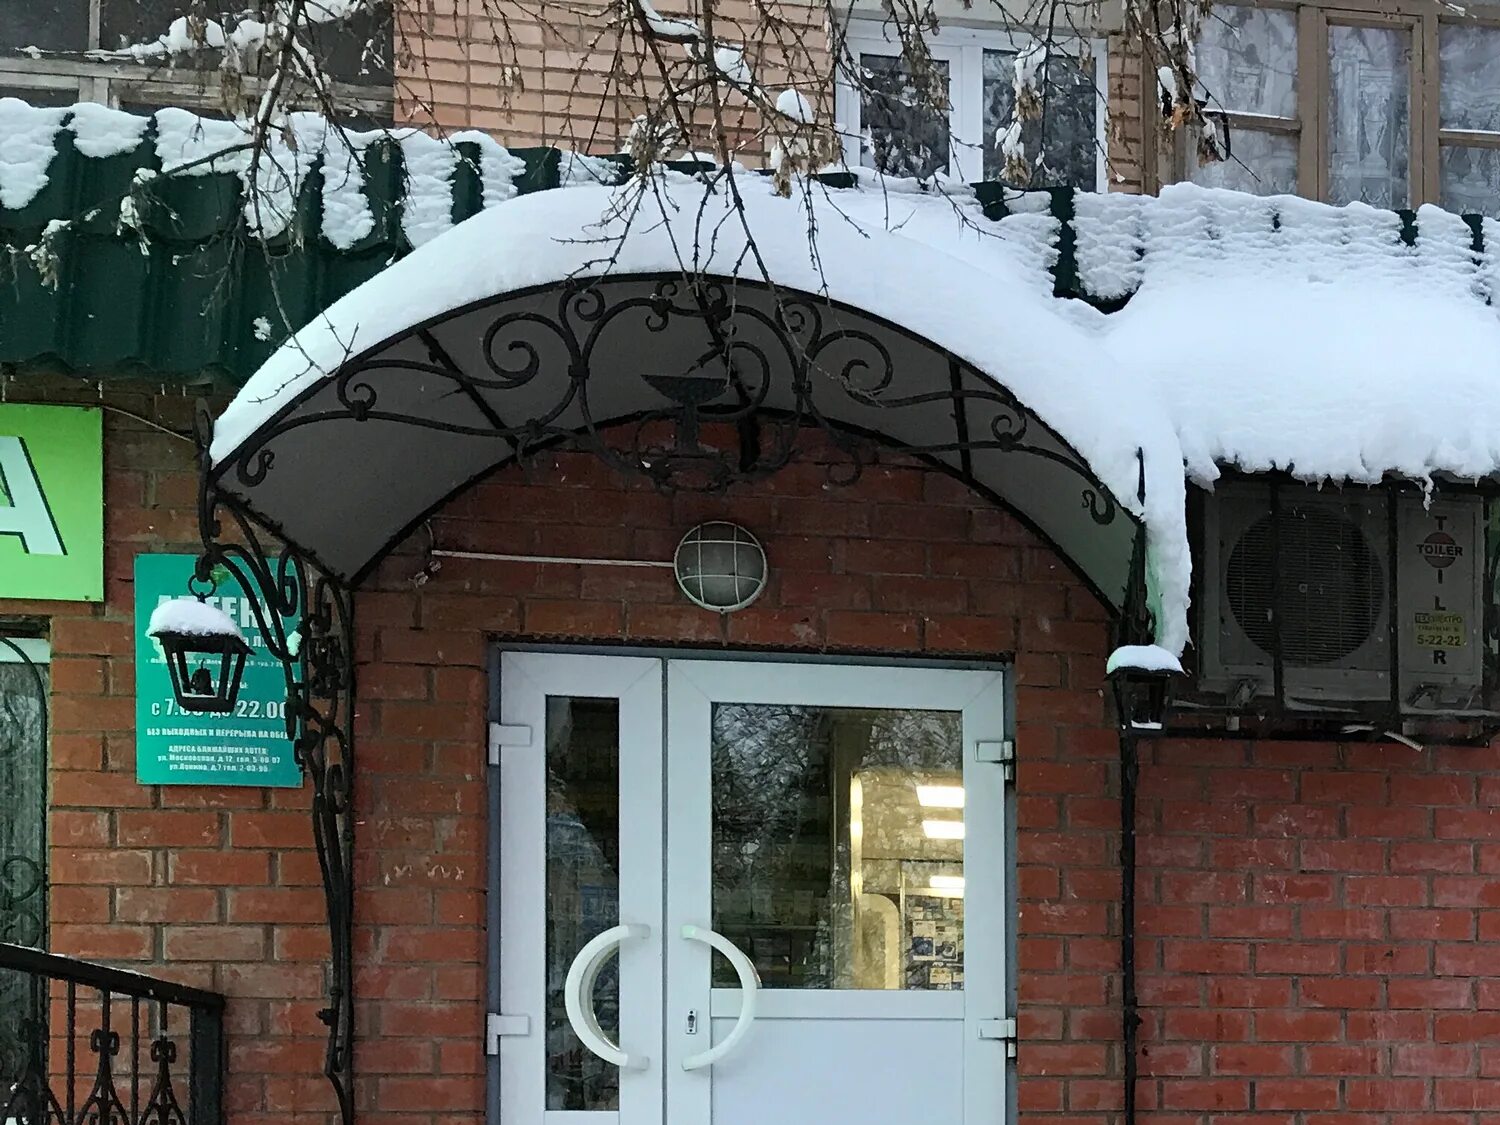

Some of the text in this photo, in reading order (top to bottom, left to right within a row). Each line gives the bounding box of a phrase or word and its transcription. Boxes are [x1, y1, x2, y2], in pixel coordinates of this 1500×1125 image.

[1416, 544, 1463, 556] TOILER
[1417, 634, 1462, 647] 5-22-22
[146, 727, 161, 736] БЕЗ
[162, 728, 207, 737] ВЫХОДНЫХ
